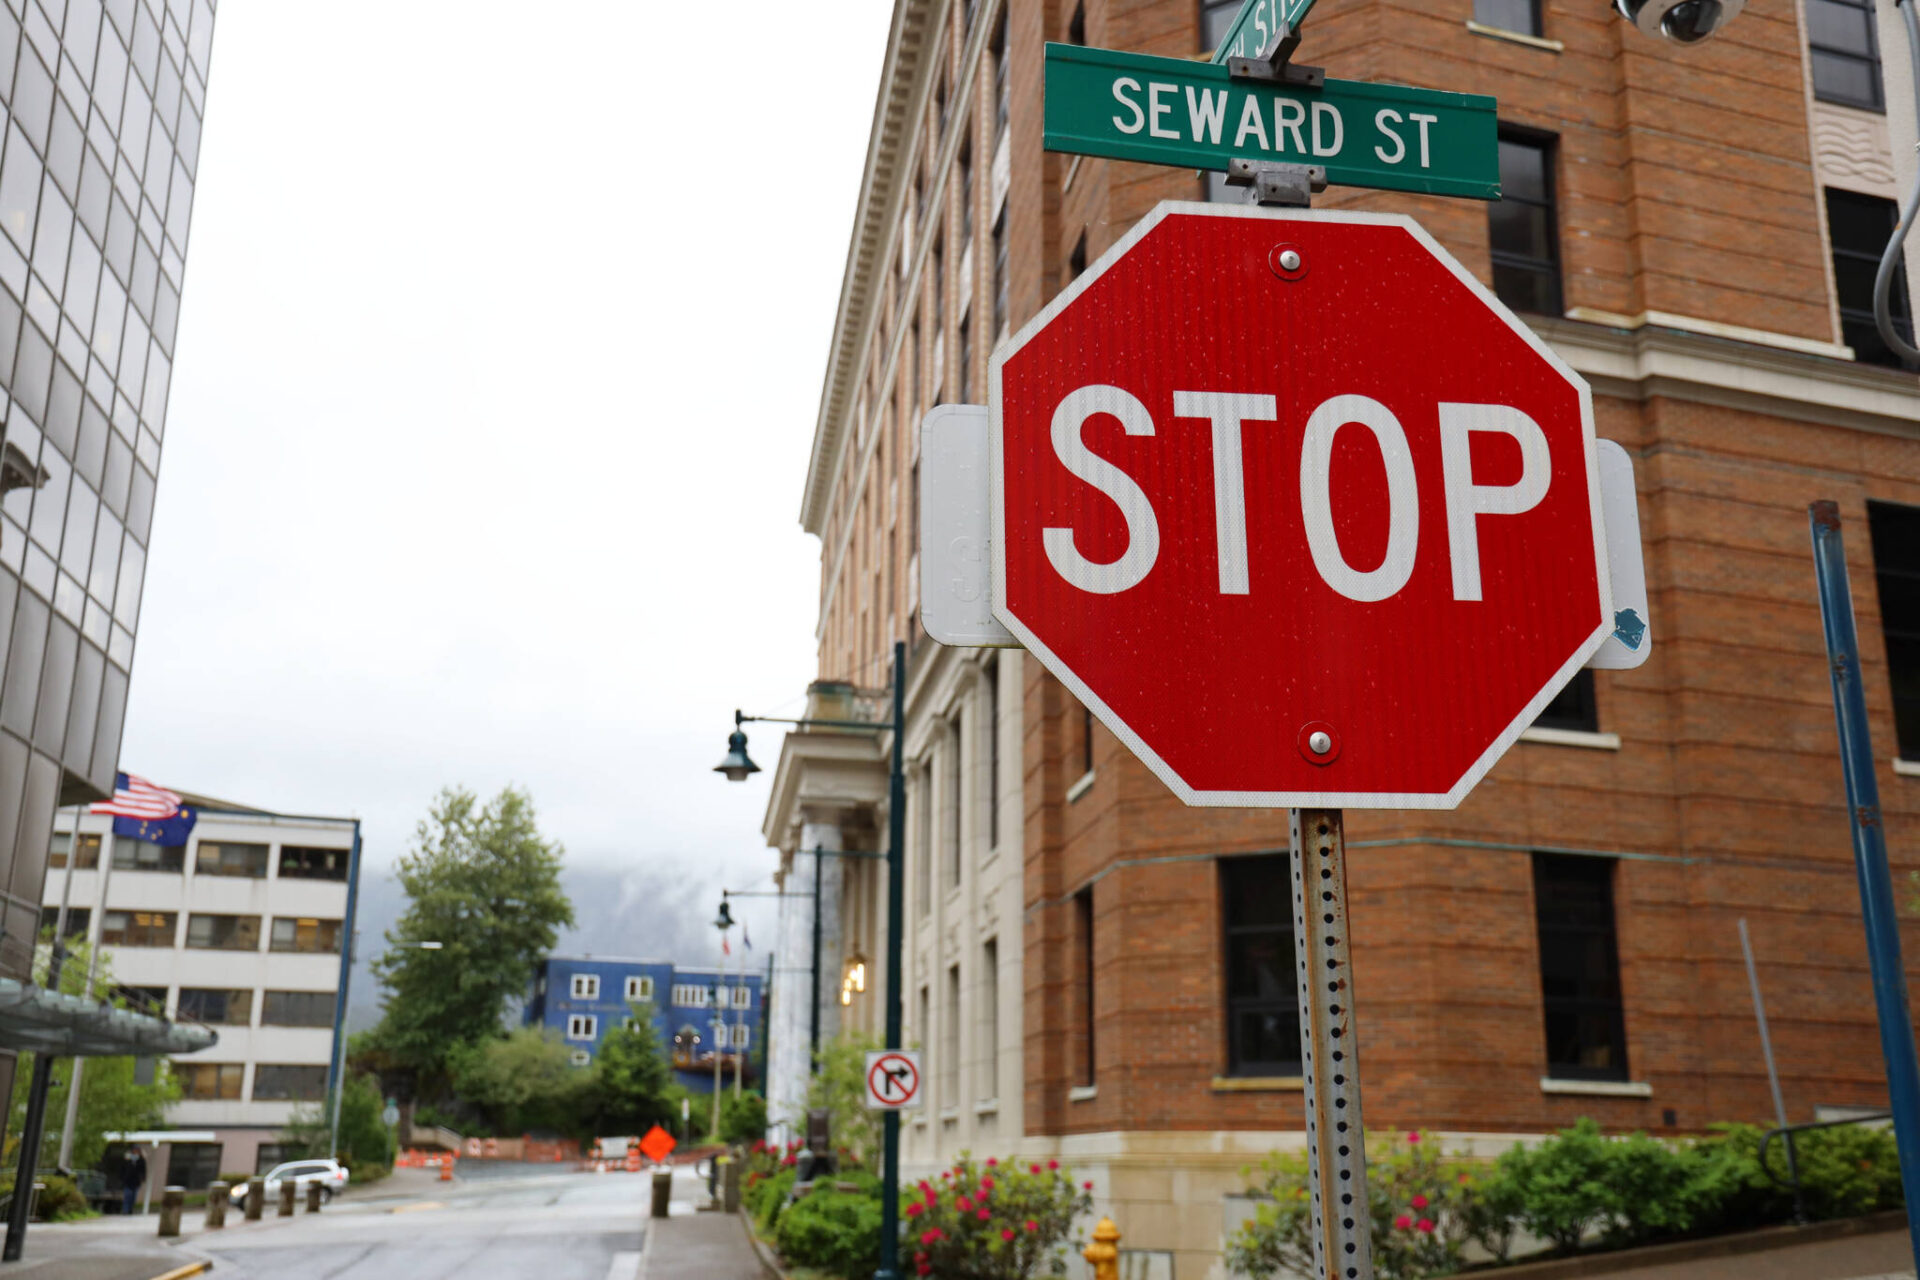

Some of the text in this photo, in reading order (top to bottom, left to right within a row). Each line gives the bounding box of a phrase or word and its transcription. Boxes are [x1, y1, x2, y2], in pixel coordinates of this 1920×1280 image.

[1112, 77, 1438, 168] SEWARD ST
[1042, 384, 1552, 602] STOP
